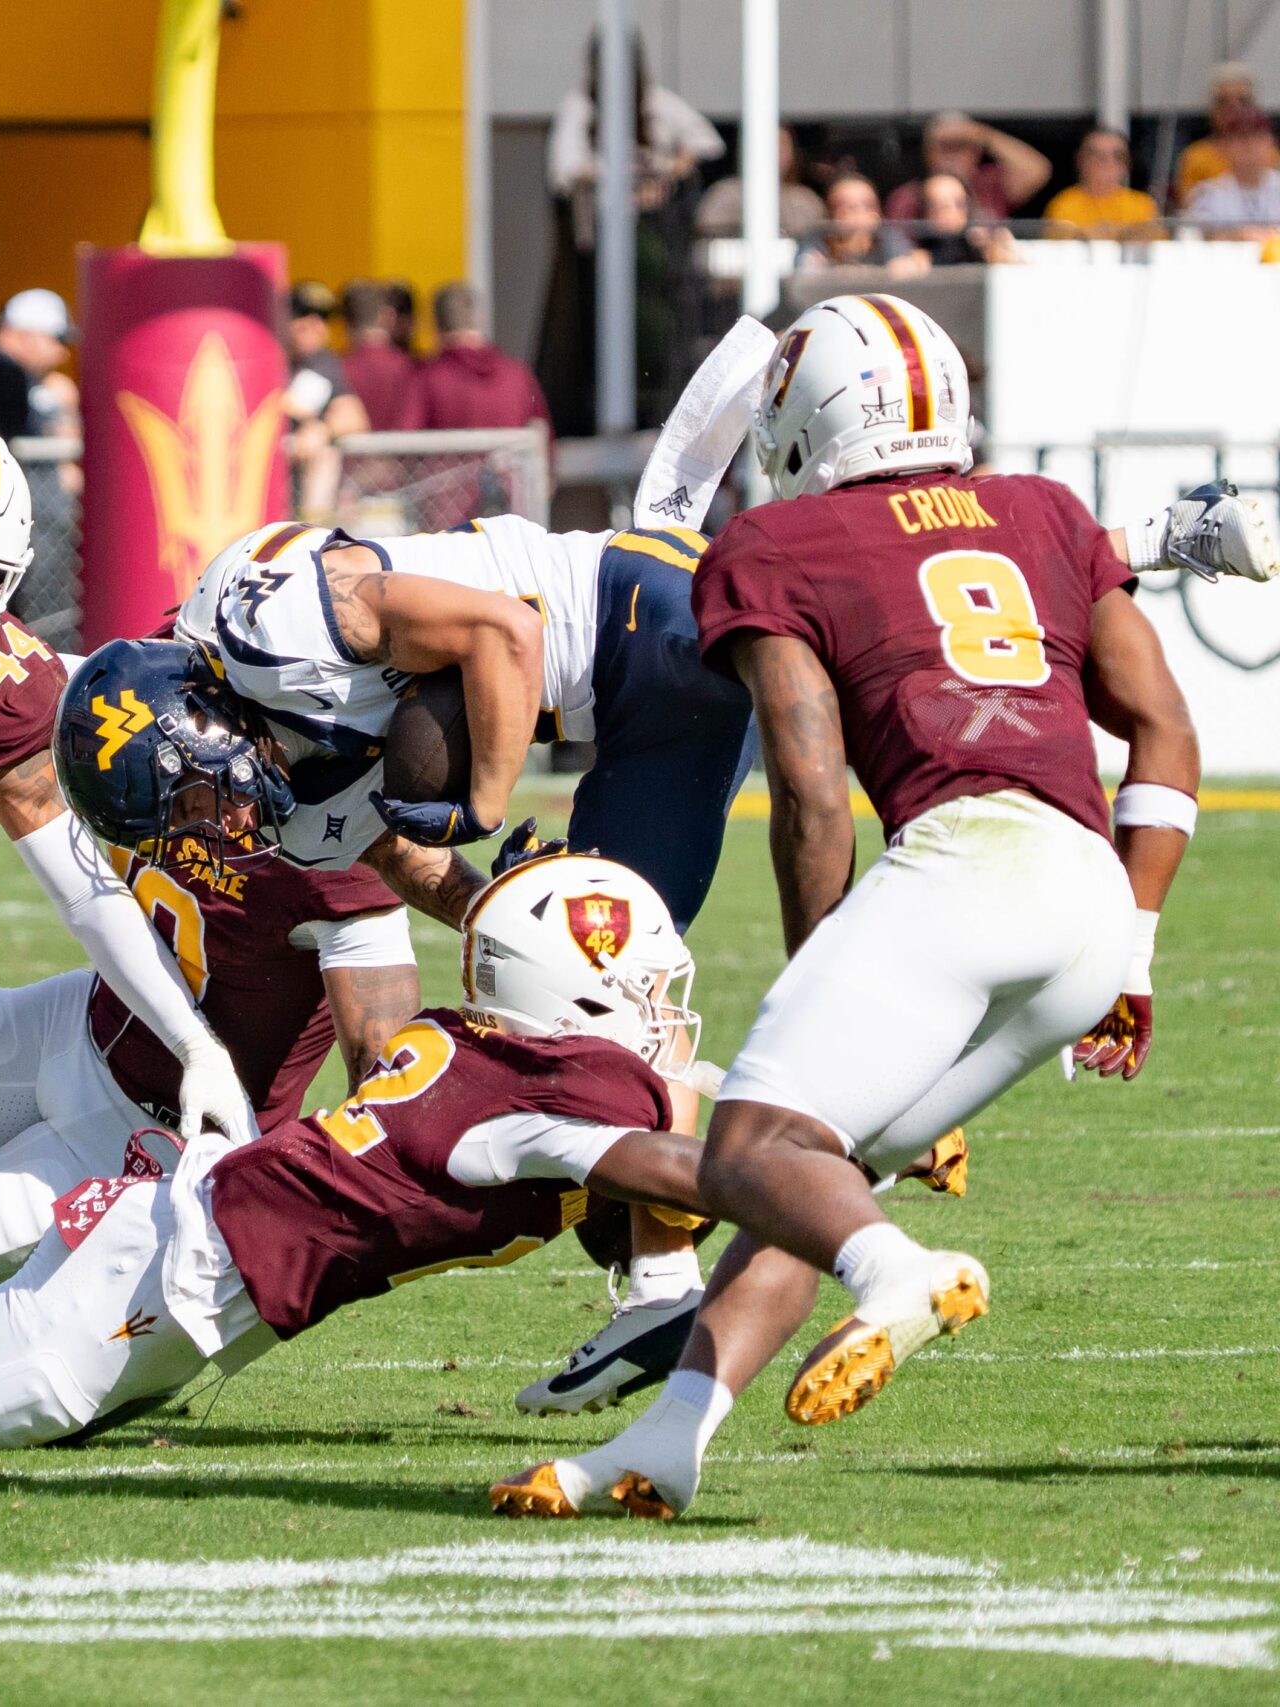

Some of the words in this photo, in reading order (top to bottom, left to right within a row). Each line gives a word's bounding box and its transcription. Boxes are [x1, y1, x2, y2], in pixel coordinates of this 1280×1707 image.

[890, 438, 914, 453] SUN
[917, 435, 949, 448] DEVILS
[888, 486, 999, 534] CROOK
[917, 549, 1051, 687] 8
[176, 837, 249, 902] STATE
[584, 899, 613, 923] PT
[585, 929, 616, 954] 42
